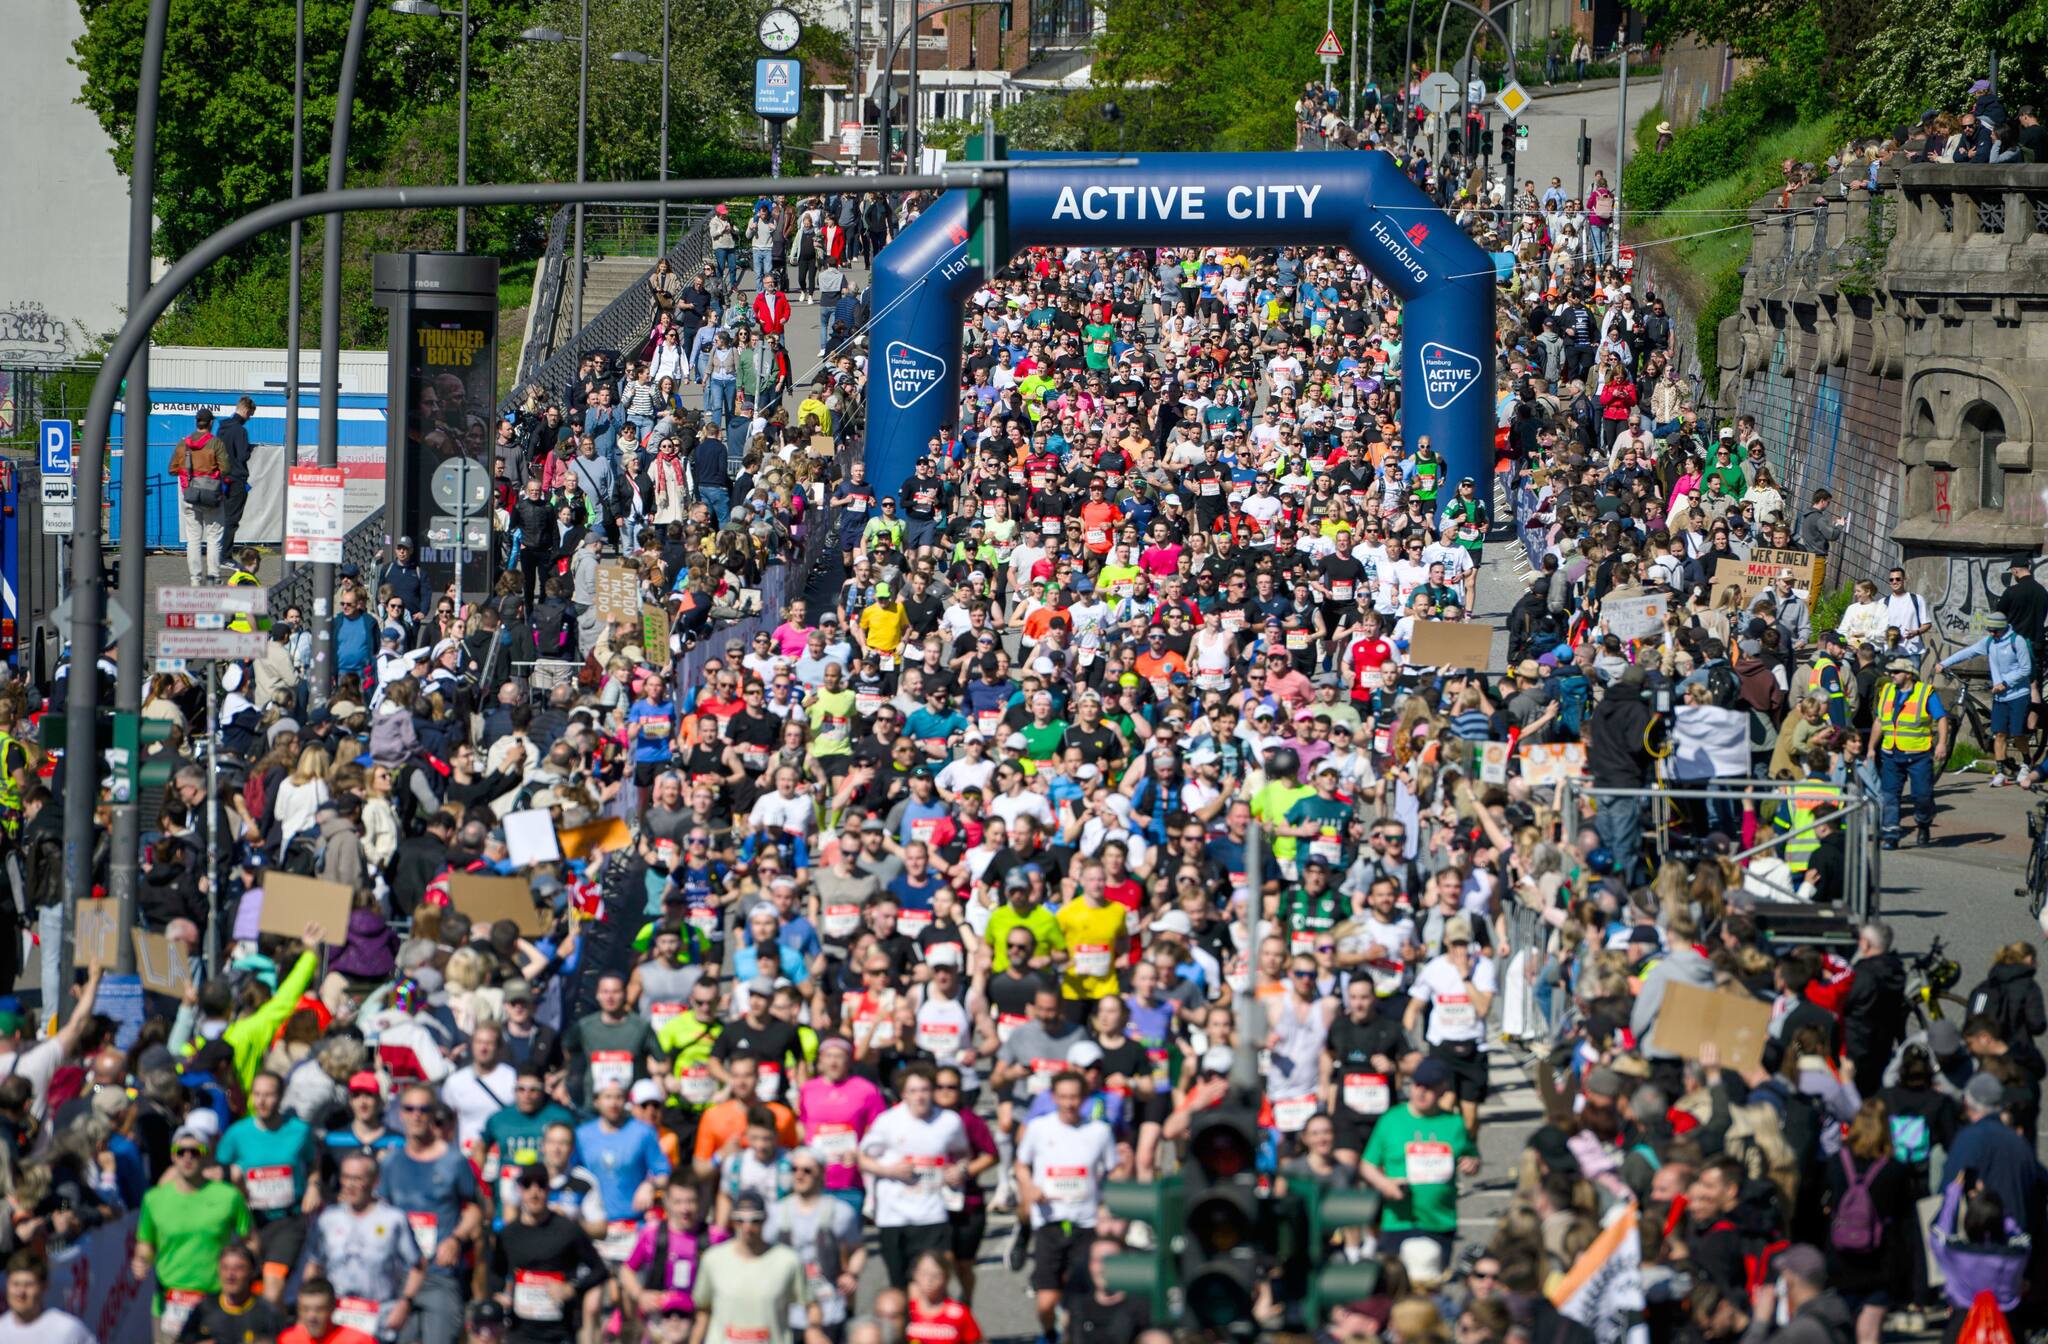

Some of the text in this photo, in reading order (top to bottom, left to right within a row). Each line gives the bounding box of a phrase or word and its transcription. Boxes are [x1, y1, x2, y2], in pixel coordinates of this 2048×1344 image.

[1051, 184, 1322, 220] ACTIVE CITY
[1369, 221, 1429, 283] Hamburg
[417, 329, 485, 348] THUNDER
[891, 358, 916, 366] Hamburg
[893, 369, 936, 380] ACTIVE
[1429, 369, 1472, 380] ACTIVE
[894, 381, 921, 392] CITY
[1430, 381, 1457, 392] CITY
[47, 427, 64, 467] P
[45, 519, 71, 528] Parkschein
[420, 547, 473, 563] IM KIO
[1750, 548, 1809, 567] WER EINEN
[1746, 575, 1764, 585] HAT
